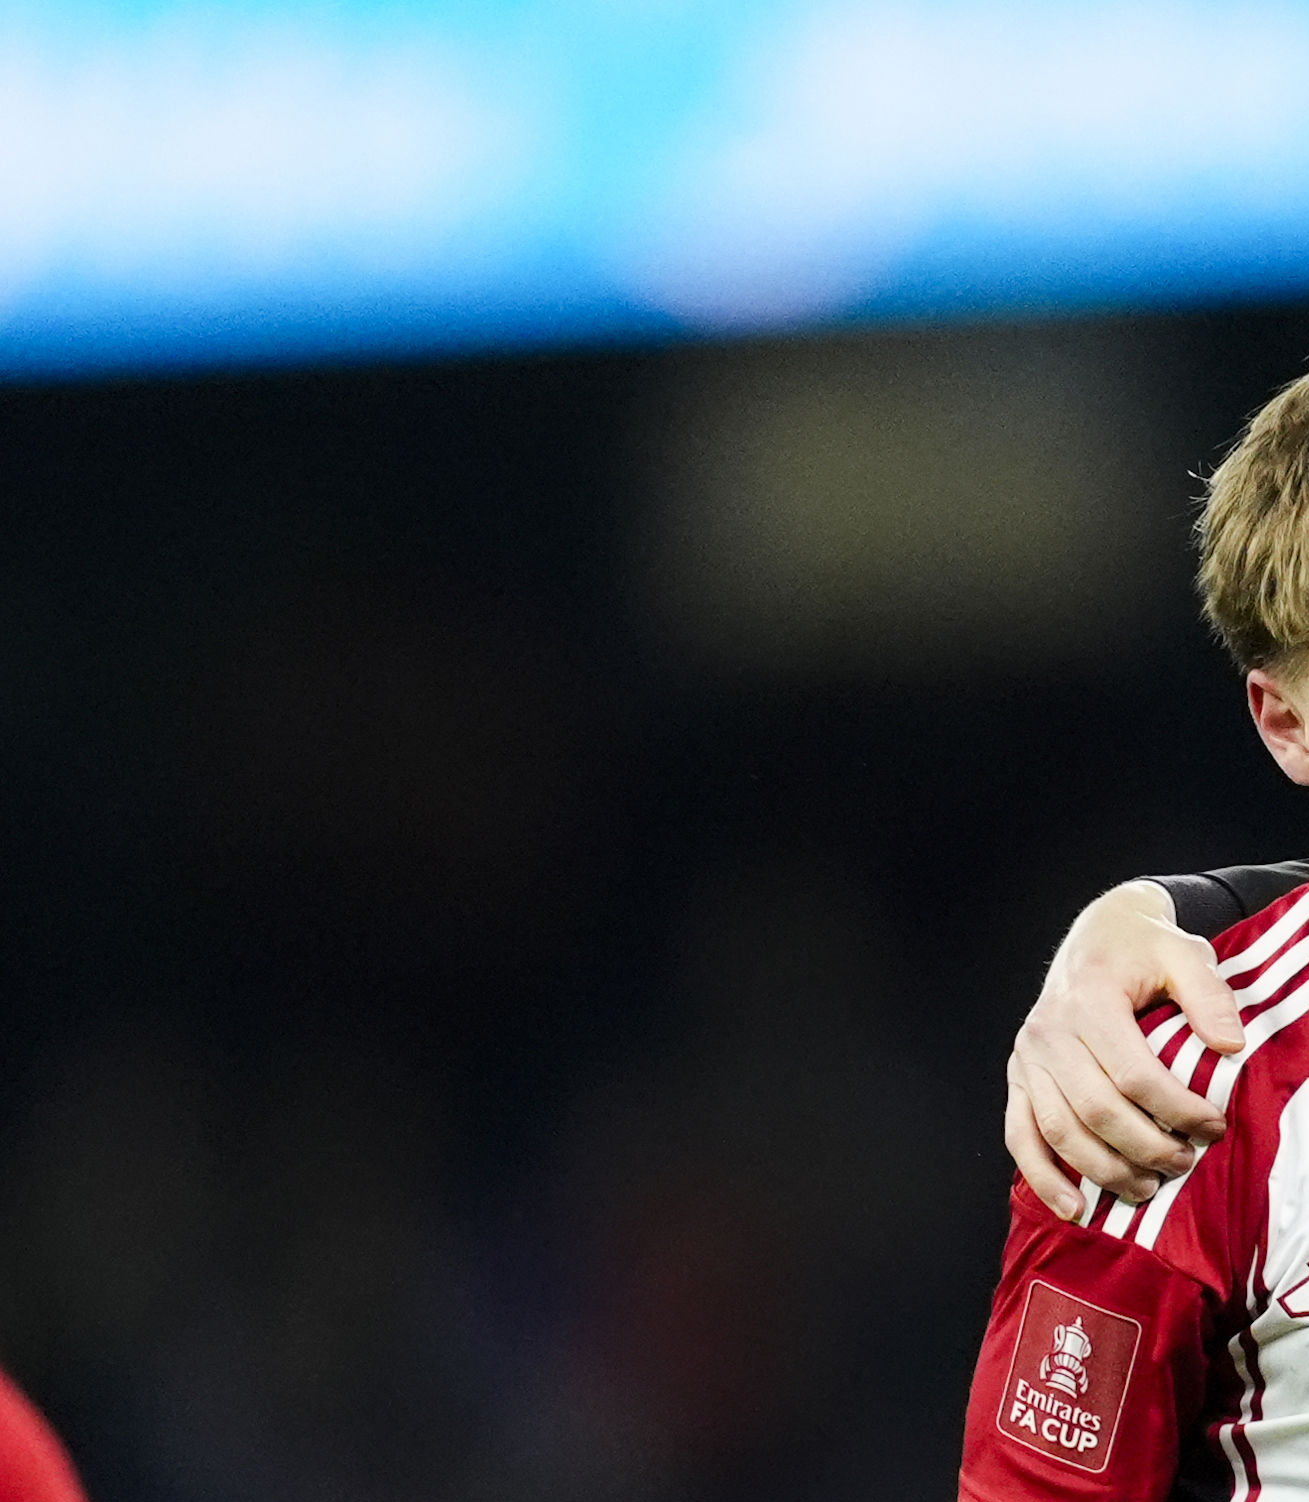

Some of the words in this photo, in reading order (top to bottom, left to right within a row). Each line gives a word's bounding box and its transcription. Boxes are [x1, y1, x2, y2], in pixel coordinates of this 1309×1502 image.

[1009, 1401, 1037, 1435] FA
[1041, 1418, 1098, 1453] CUP
[1016, 1378, 1101, 1432] Emirates
